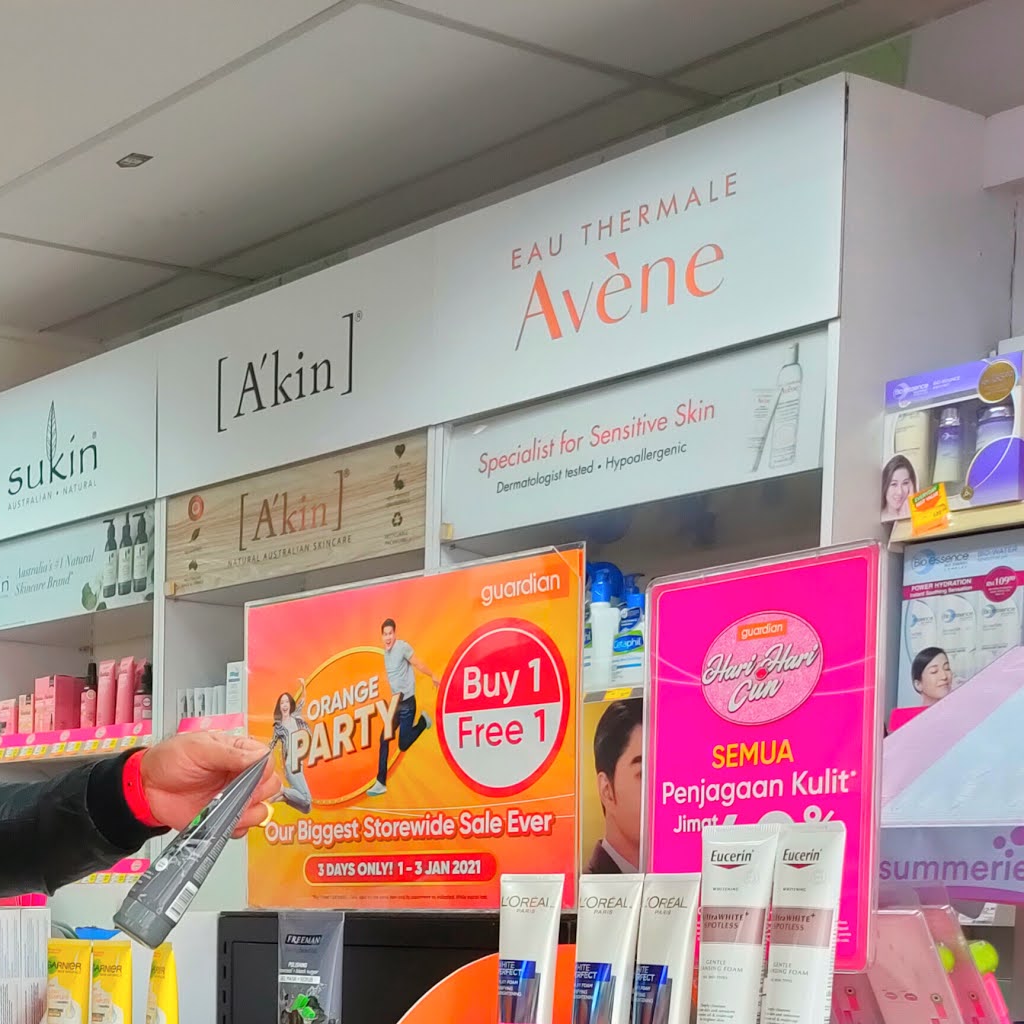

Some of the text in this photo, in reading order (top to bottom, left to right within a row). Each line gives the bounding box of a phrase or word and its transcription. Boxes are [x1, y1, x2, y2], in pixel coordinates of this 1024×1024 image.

[511, 172, 738, 270] EAU THERMALE
[515, 243, 725, 351] Avène
[478, 399, 715, 478] Specialist for Sensitive Skin
[7, 424, 98, 495] sukin
[496, 441, 687, 494] Dermatologist tested Hypoallergenic
[7, 479, 97, 511] AUSTRALIAN NATURAL
[17, 560, 52, 580] Australia's
[65, 551, 94, 569] Natural
[227, 535, 352, 568] NATURAL AUSTRALIAN SKINCARE
[15, 579, 46, 596] Skincare
[481, 571, 560, 606] guardian
[911, 578, 971, 591] POWER HYDRATION
[741, 622, 783, 640] guardian
[463, 658, 542, 704] Buy 1
[307, 676, 379, 721] ORANGE
[291, 692, 403, 775] PARTY
[458, 709, 546, 748] Free 1
[711, 739, 794, 769] SEMUA
[663, 777, 783, 809] Penjagaan
[264, 808, 553, 847] Our Biggest Storewide Sale Ever
[317, 864, 325, 876] 3
[326, 863, 356, 876] DAYS
[357, 862, 393, 876] ONLY!
[397, 862, 403, 874] 1
[414, 861, 423, 874] 3
[424, 860, 450, 875] JAN
[452, 859, 481, 874] 2021
[710, 850, 752, 862] Eucerin
[782, 848, 820, 861] Eucerin
[286, 935, 321, 945] FREEMAN
[789, 968, 809, 976] FOAM
